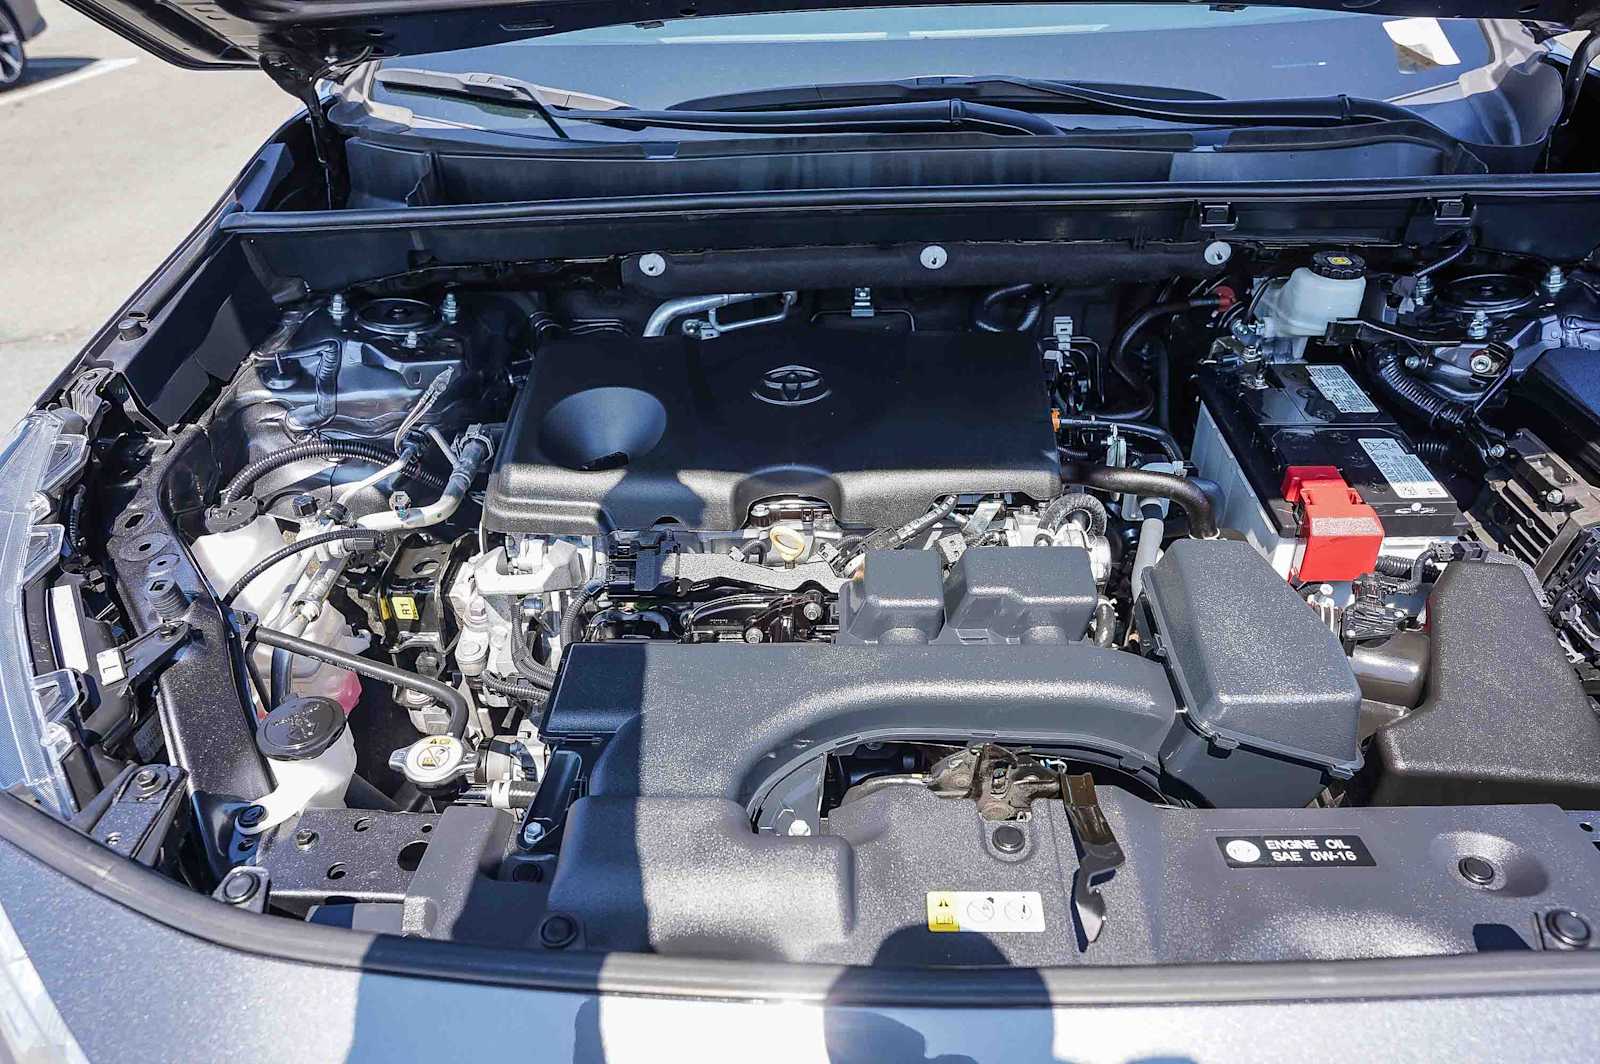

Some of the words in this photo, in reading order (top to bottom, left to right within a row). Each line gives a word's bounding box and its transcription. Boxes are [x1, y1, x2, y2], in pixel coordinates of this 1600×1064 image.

[1264, 839, 1320, 850] ENGINE
[1324, 838, 1351, 850] OIL
[1271, 850, 1304, 861] SAE
[1310, 850, 1358, 861] 0W-16
